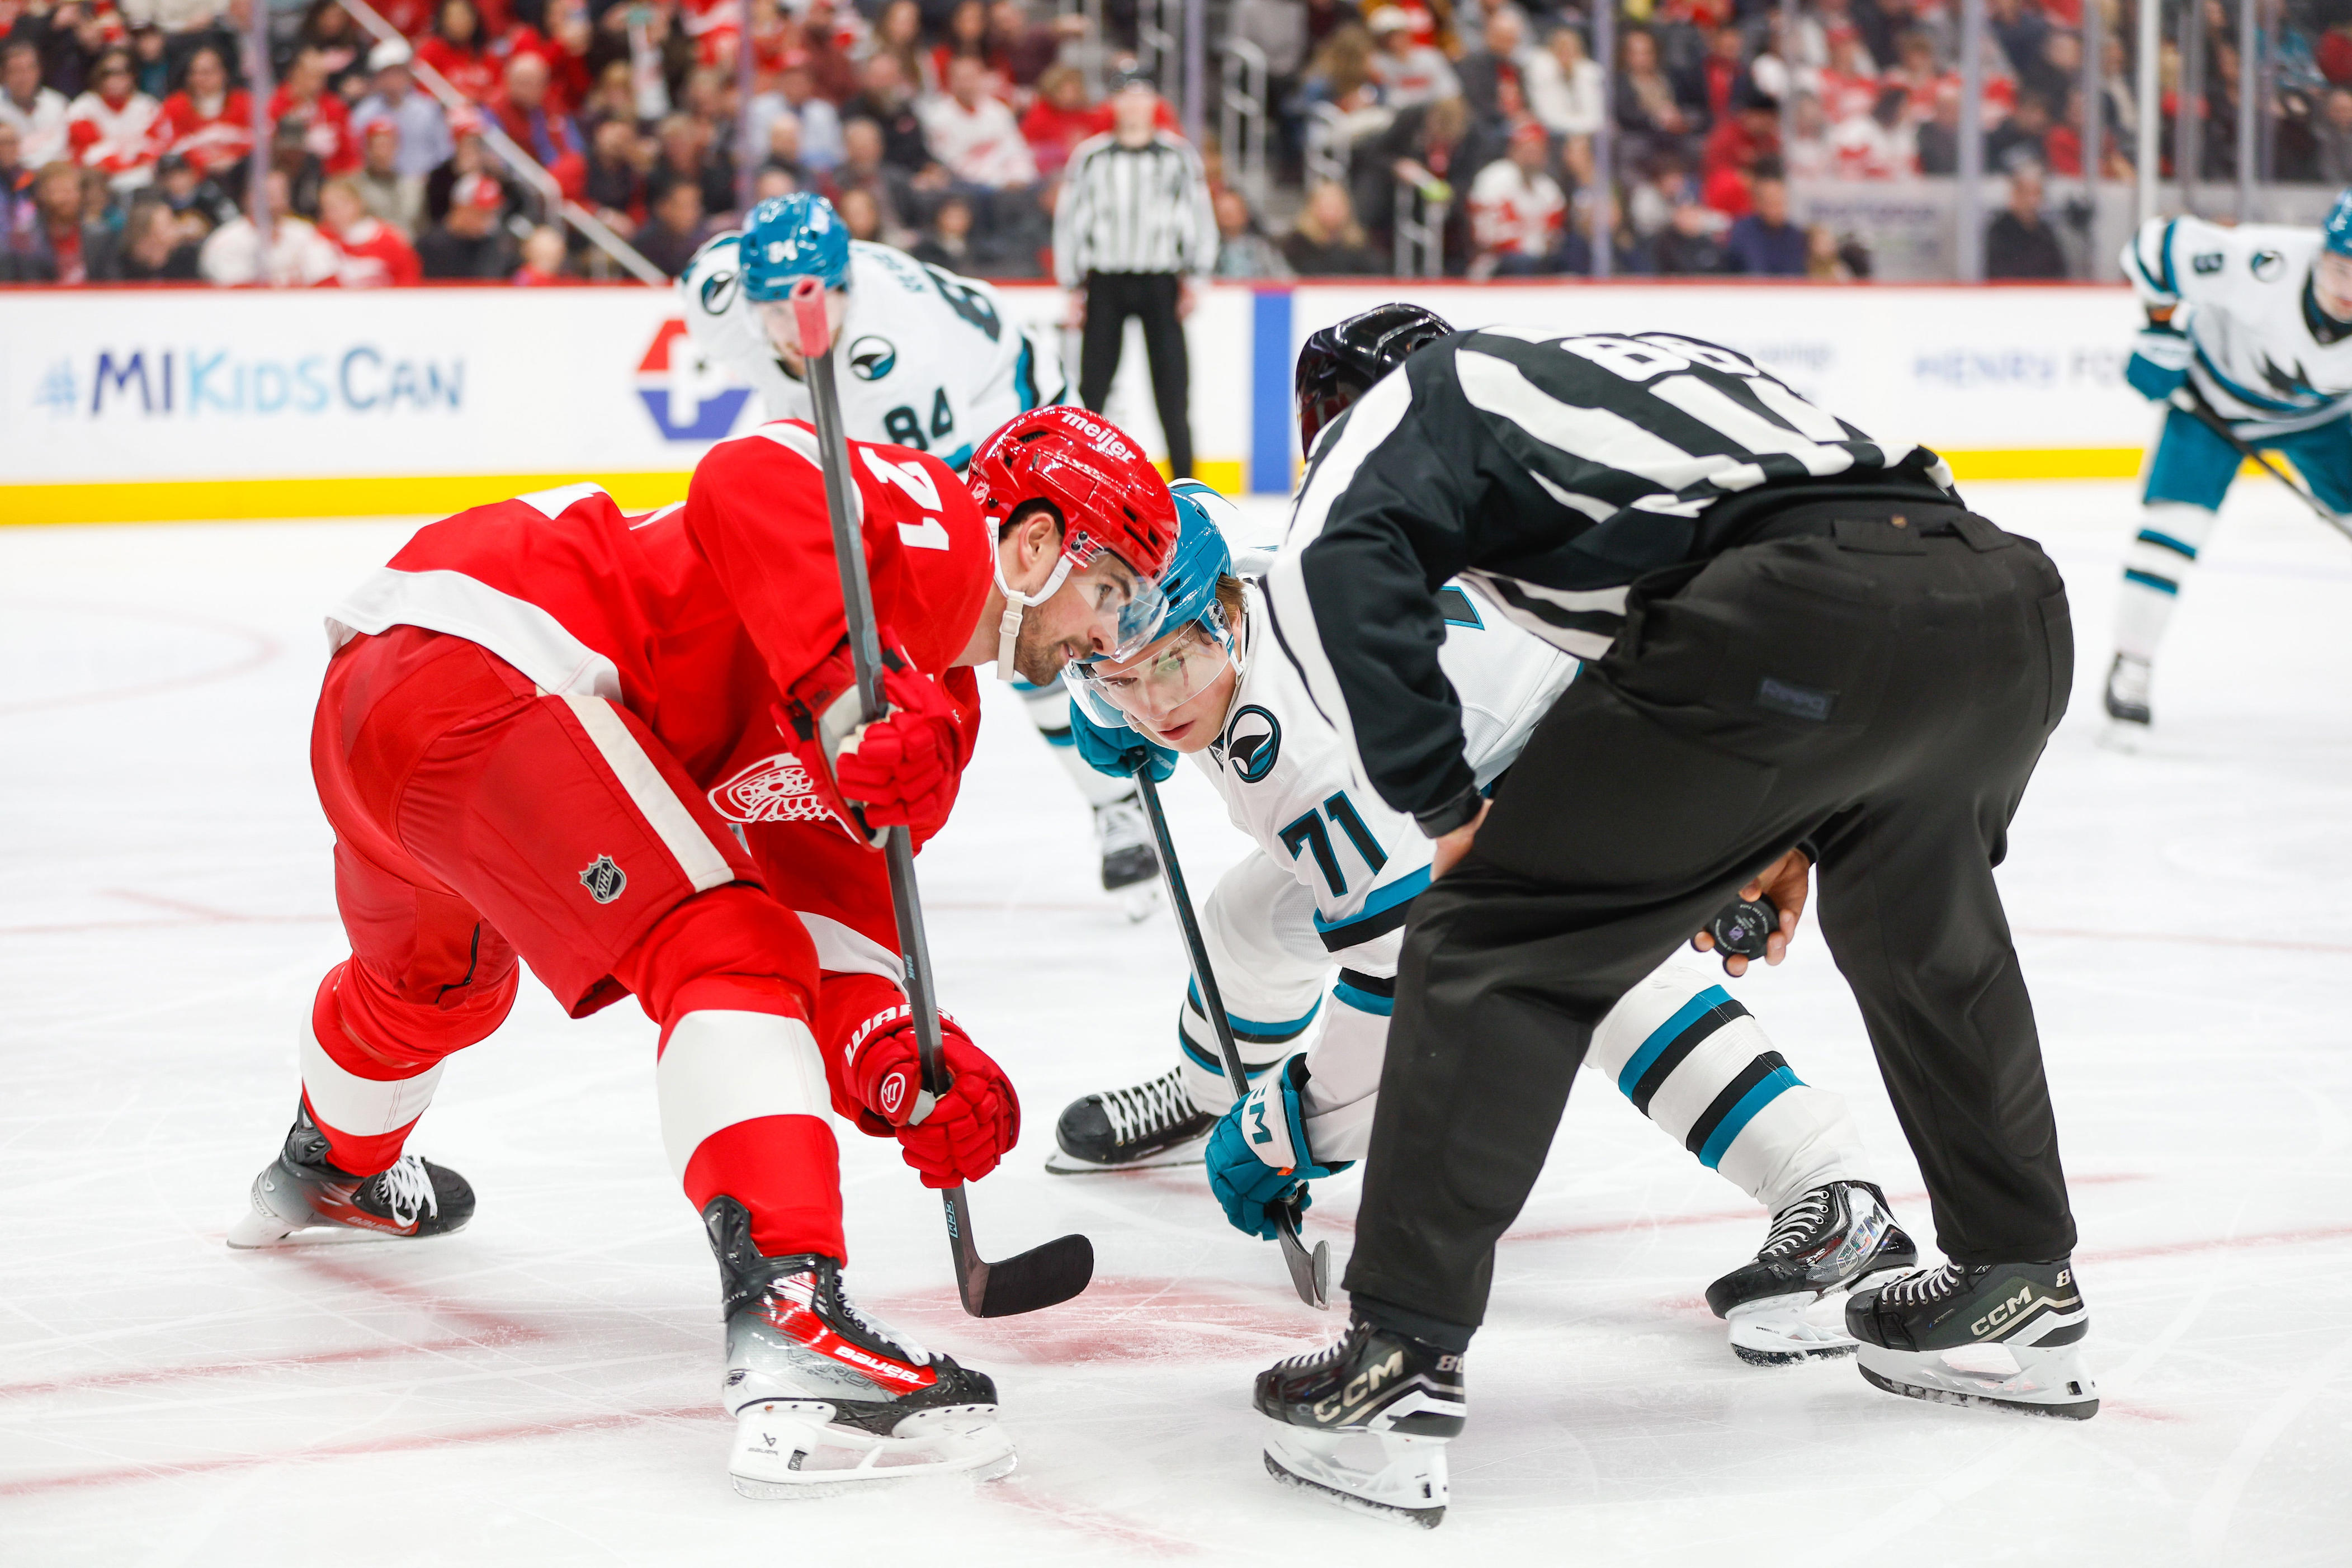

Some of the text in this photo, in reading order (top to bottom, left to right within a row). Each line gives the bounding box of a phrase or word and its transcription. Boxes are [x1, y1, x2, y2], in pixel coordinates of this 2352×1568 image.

[885, 387, 953, 452] 84
[1061, 412, 1137, 462] meijer
[858, 446, 950, 551] 71
[1278, 790, 1389, 898] 71
[597, 867, 611, 898] NHL
[1837, 1202, 1887, 1276] CCM
[1970, 1286, 2033, 1336] CCM
[1313, 1350, 1404, 1423] CCM
